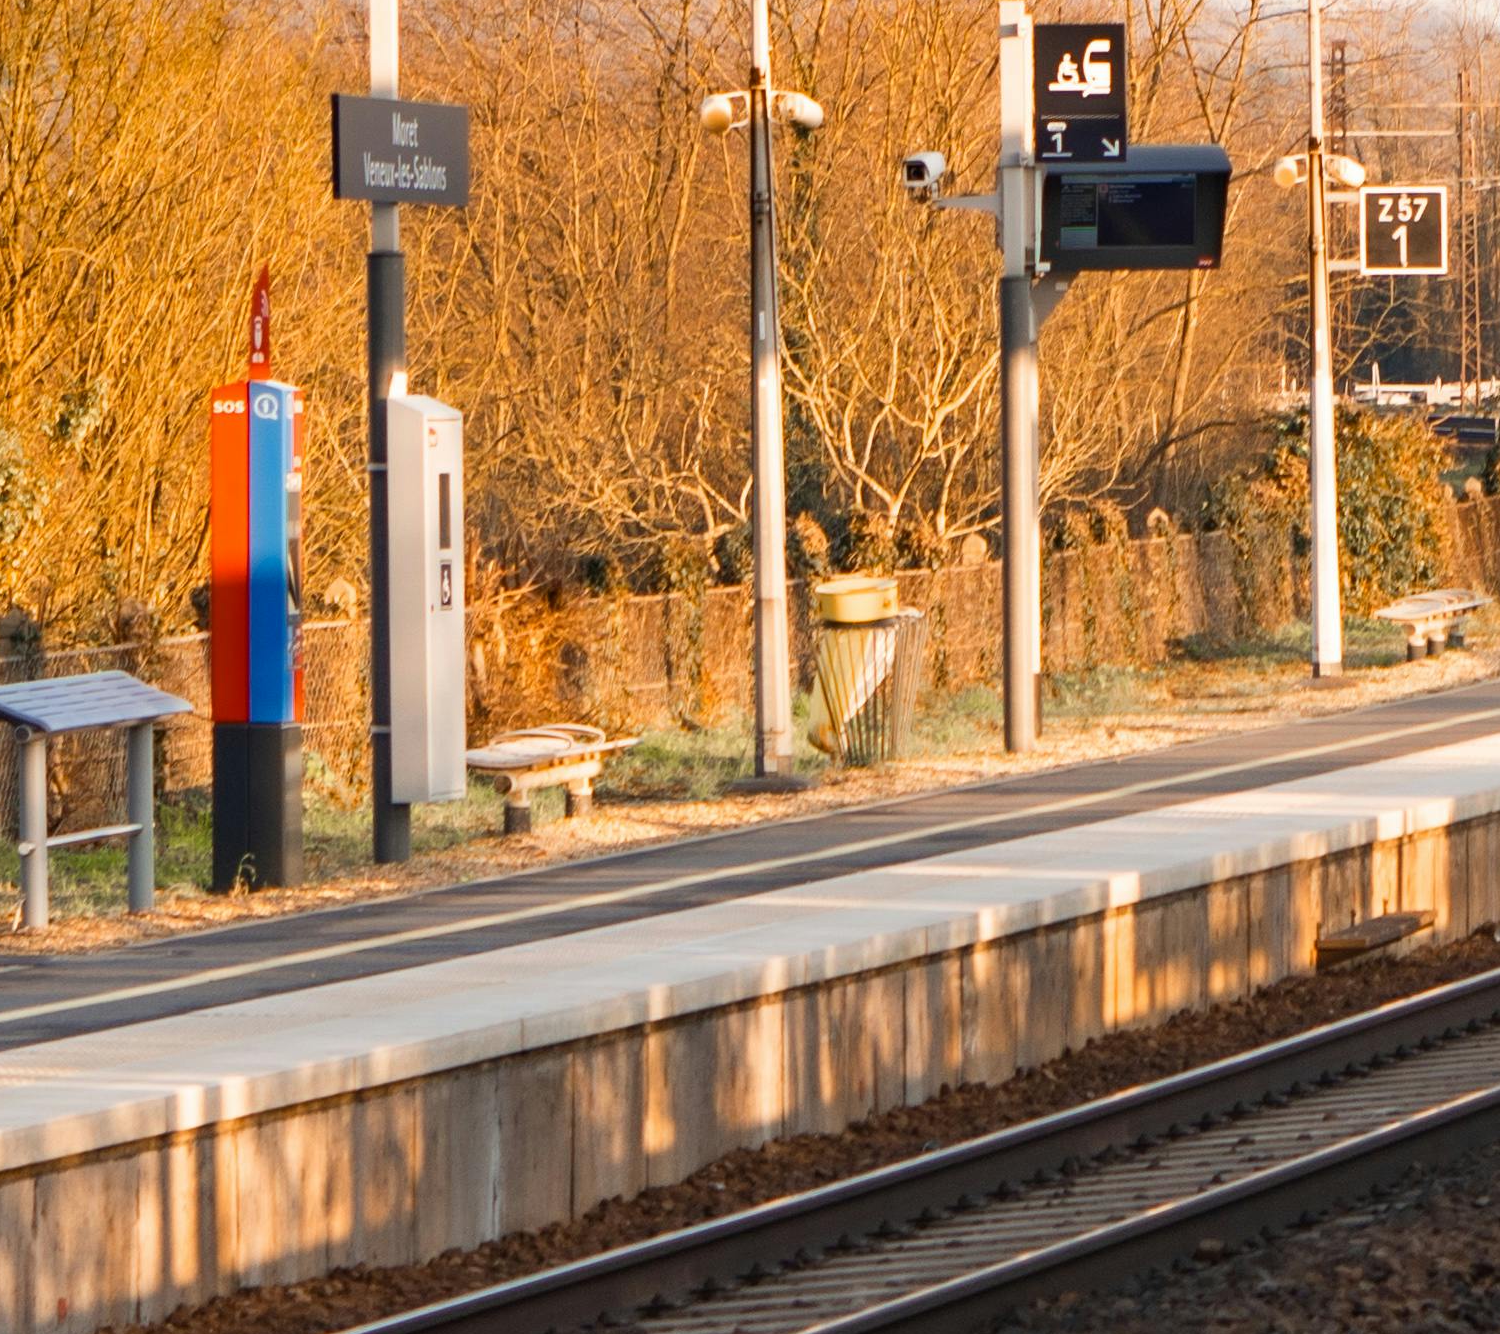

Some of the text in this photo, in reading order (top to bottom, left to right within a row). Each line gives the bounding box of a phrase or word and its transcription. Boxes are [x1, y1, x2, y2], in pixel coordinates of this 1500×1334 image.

[392, 112, 418, 147] Moret
[1051, 132, 1063, 154] 1
[363, 152, 447, 191] Veneux-les-Sablons
[1378, 197, 1429, 223] Z 57
[1391, 224, 1408, 267] 1
[213, 400, 245, 414] SOS
